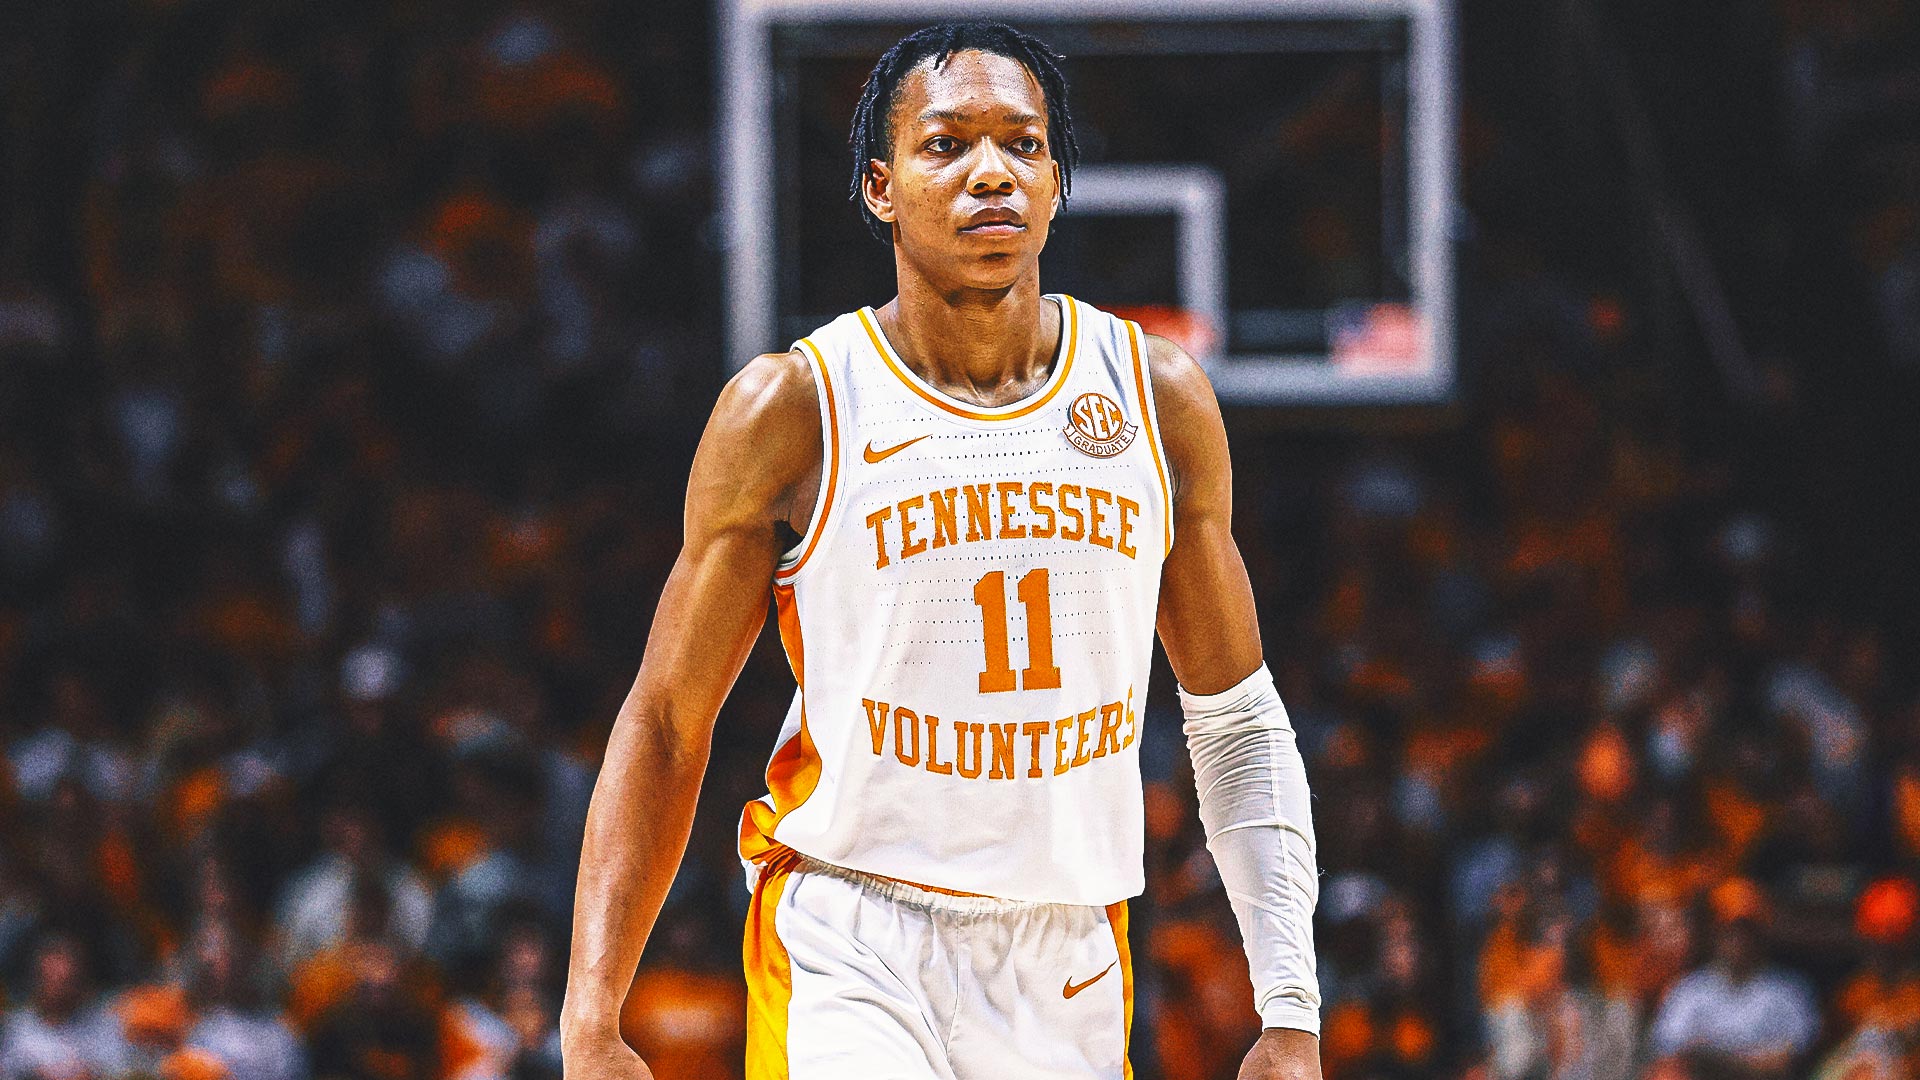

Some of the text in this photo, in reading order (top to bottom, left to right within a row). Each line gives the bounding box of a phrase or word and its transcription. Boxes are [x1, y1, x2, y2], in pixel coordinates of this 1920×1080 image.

[1073, 435, 1131, 455] GRADUATE
[1074, 395, 1121, 439] SEC
[866, 482, 1140, 570] TENNESSEE
[973, 568, 1061, 694] 11
[862, 683, 1136, 780] VOLUNTEERS
